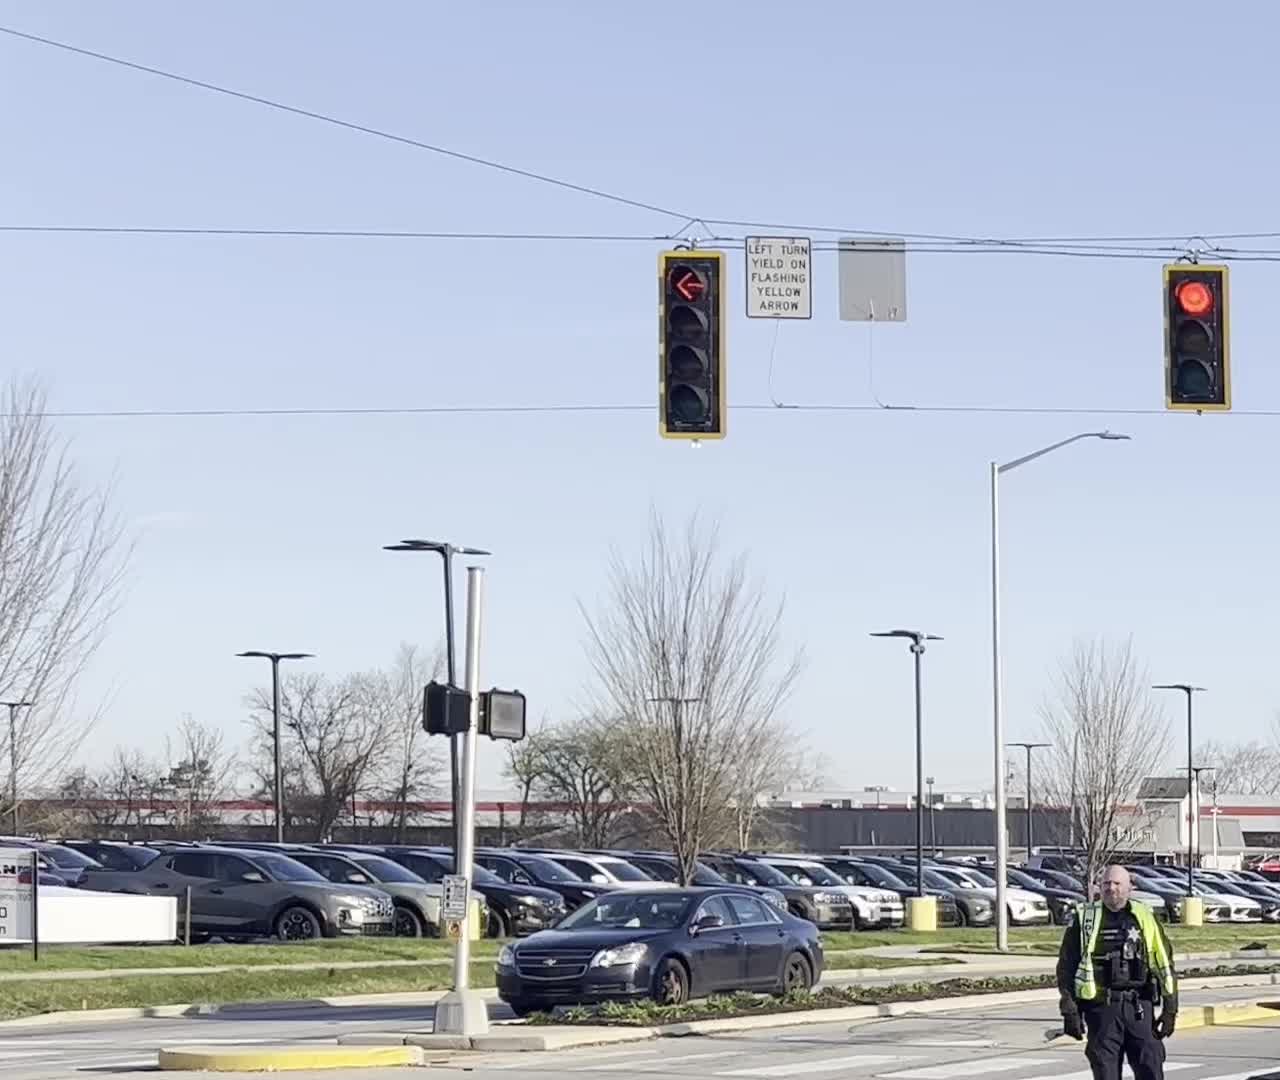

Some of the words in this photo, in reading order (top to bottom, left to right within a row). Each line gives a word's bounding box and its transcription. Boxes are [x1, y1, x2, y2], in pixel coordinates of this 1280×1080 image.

[748, 244, 772, 255] LEFT
[781, 244, 808, 255] TURN
[751, 258, 784, 269] YIELD
[790, 259, 806, 270] ON
[751, 272, 806, 284] FLASHING
[756, 287, 801, 297] YELLOW
[759, 300, 799, 311] ARROW
